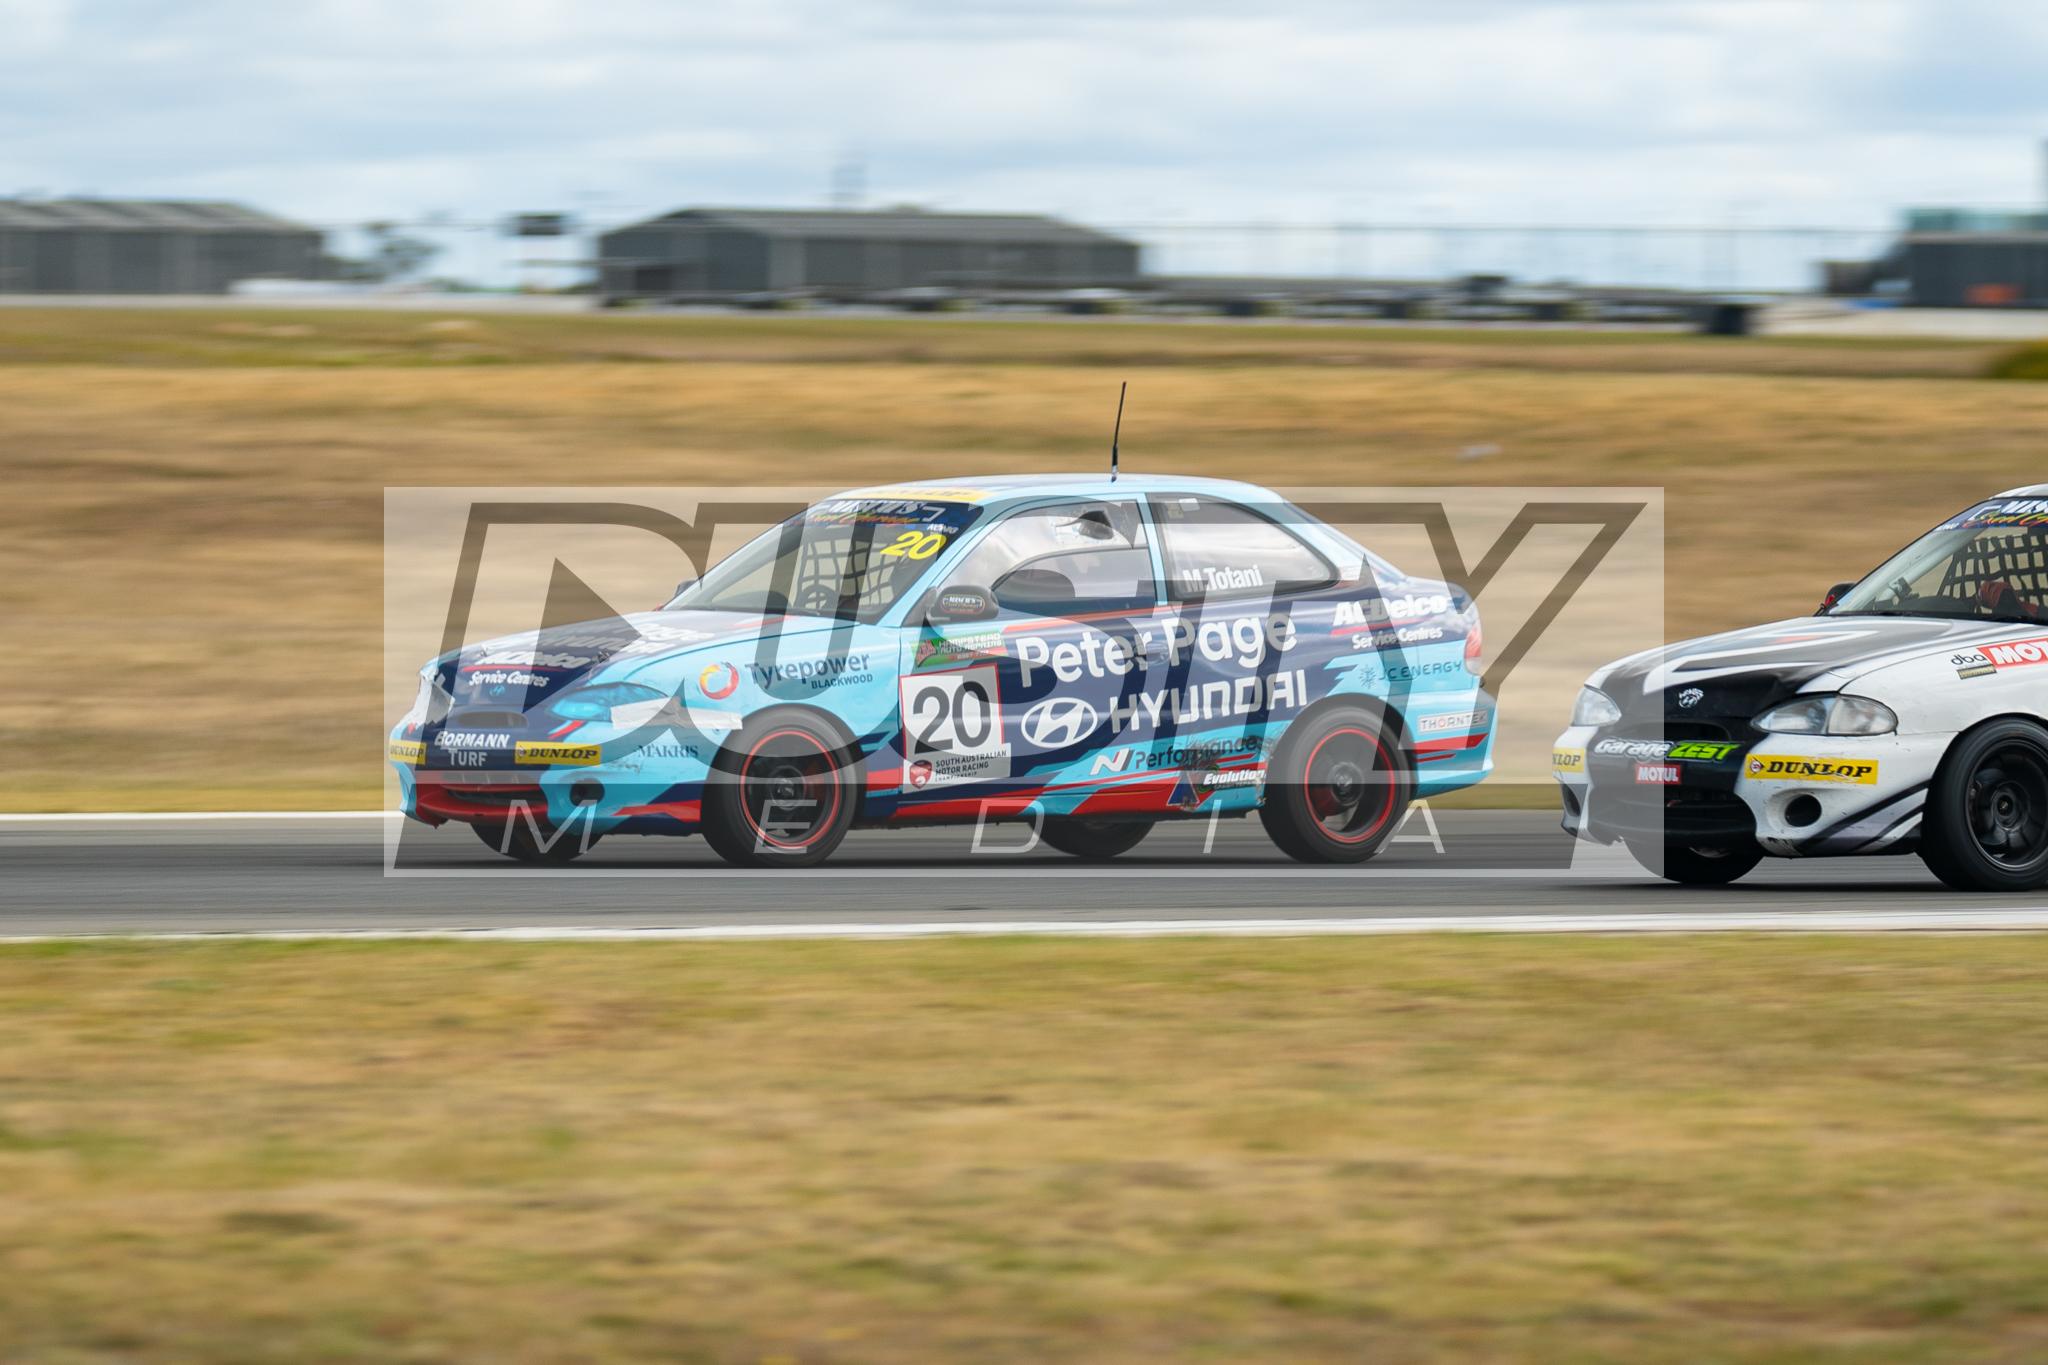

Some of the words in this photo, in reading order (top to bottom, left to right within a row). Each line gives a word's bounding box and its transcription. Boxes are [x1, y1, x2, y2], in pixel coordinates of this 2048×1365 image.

[881, 531, 946, 560] 20
[1352, 630, 1398, 649] Service
[1398, 626, 1443, 642] Centres
[1015, 629, 1152, 688] Peter
[1161, 612, 1298, 669] Page
[1951, 653, 1987, 666] dba
[744, 653, 870, 689] Tyrepower
[1400, 660, 1463, 678] ENERGY
[469, 670, 507, 686] Service
[507, 672, 550, 687] Centres
[811, 673, 873, 690] BLACKWOOD
[1109, 669, 1308, 734] HYUNDAI
[913, 681, 992, 755] 20
[434, 731, 511, 749] BORMANN
[1594, 738, 1671, 759] Garage
[1669, 740, 1742, 760] ZEST
[449, 748, 488, 766] TURF
[528, 747, 598, 760] DUNLOP
[935, 756, 960, 768] SOUTH
[961, 750, 1007, 764] AUSTRALIAN
[935, 765, 960, 776] MOTOR
[962, 761, 989, 771] RACING
[1203, 768, 1266, 786] Evolution
[1637, 766, 1679, 782] MOTUL
[1766, 761, 1873, 777] DUNLOP
